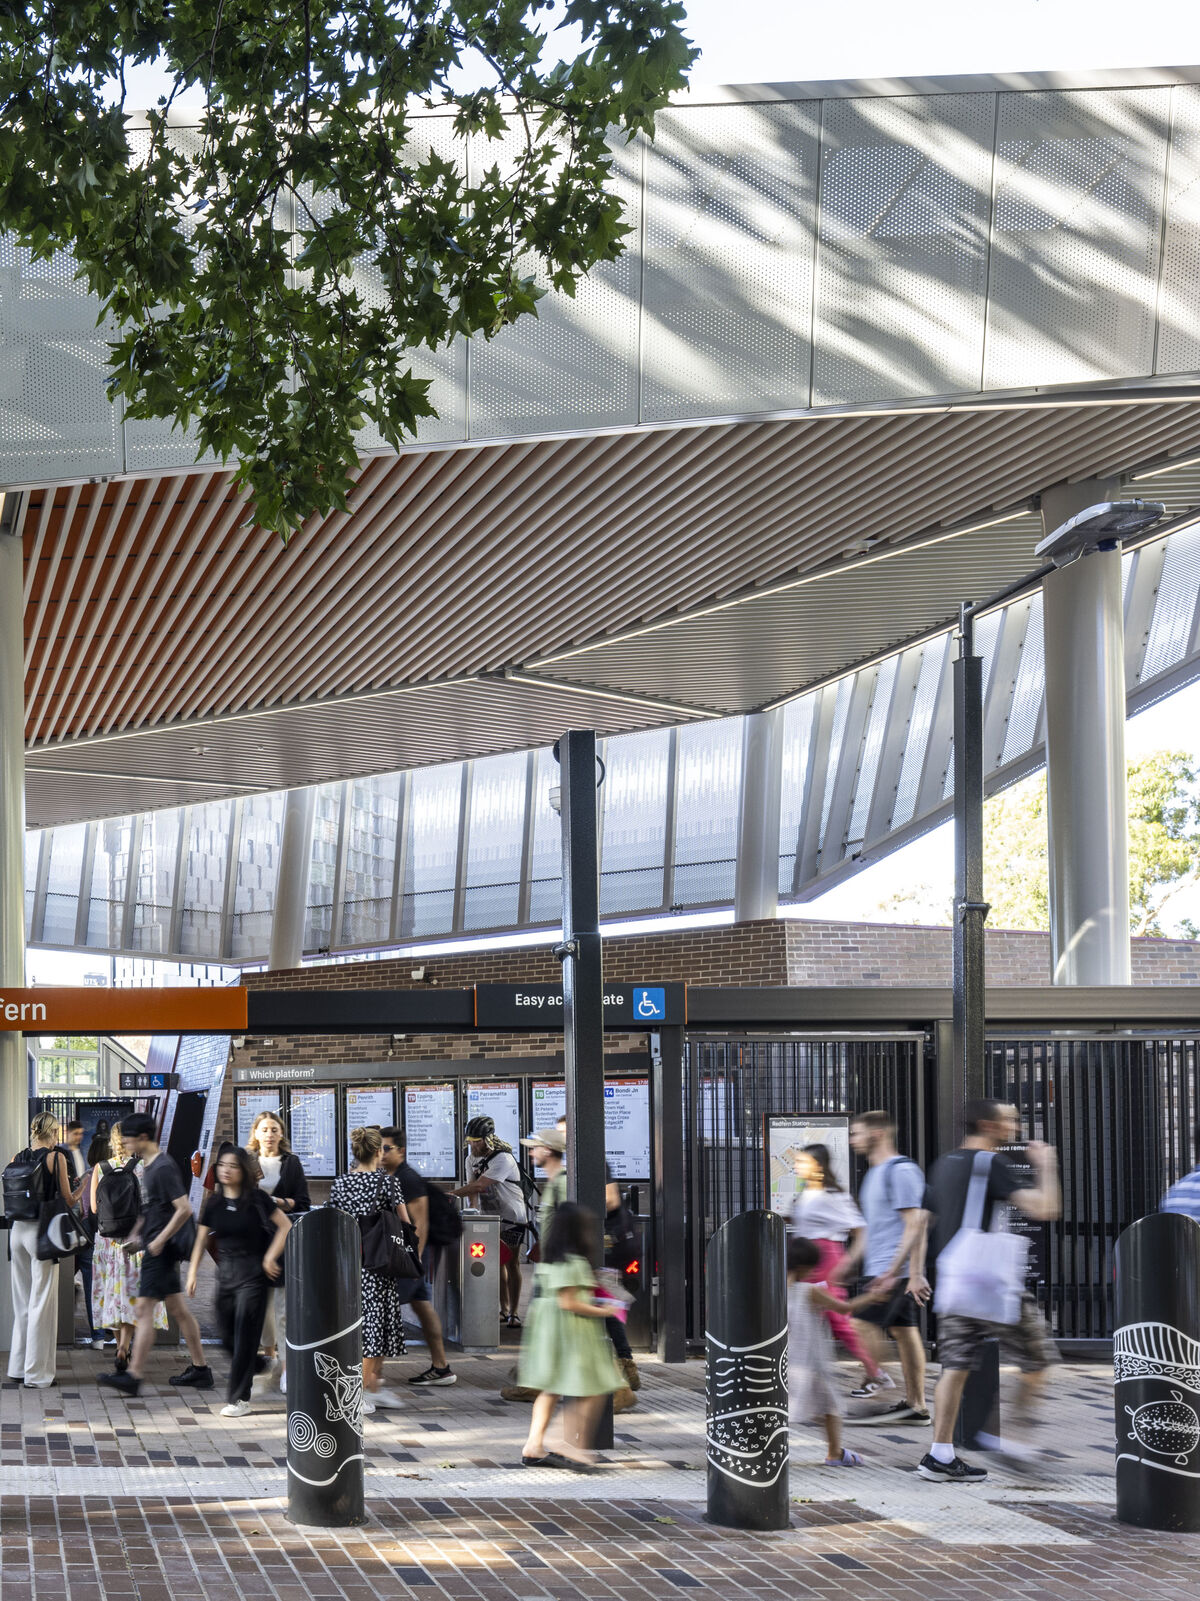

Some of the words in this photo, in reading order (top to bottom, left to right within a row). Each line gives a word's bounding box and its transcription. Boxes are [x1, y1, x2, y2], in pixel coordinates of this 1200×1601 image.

[515, 993, 545, 1008] Easy
[602, 994, 625, 1005] ate
[249, 1070, 275, 1079] Which
[276, 1068, 315, 1081] platform?
